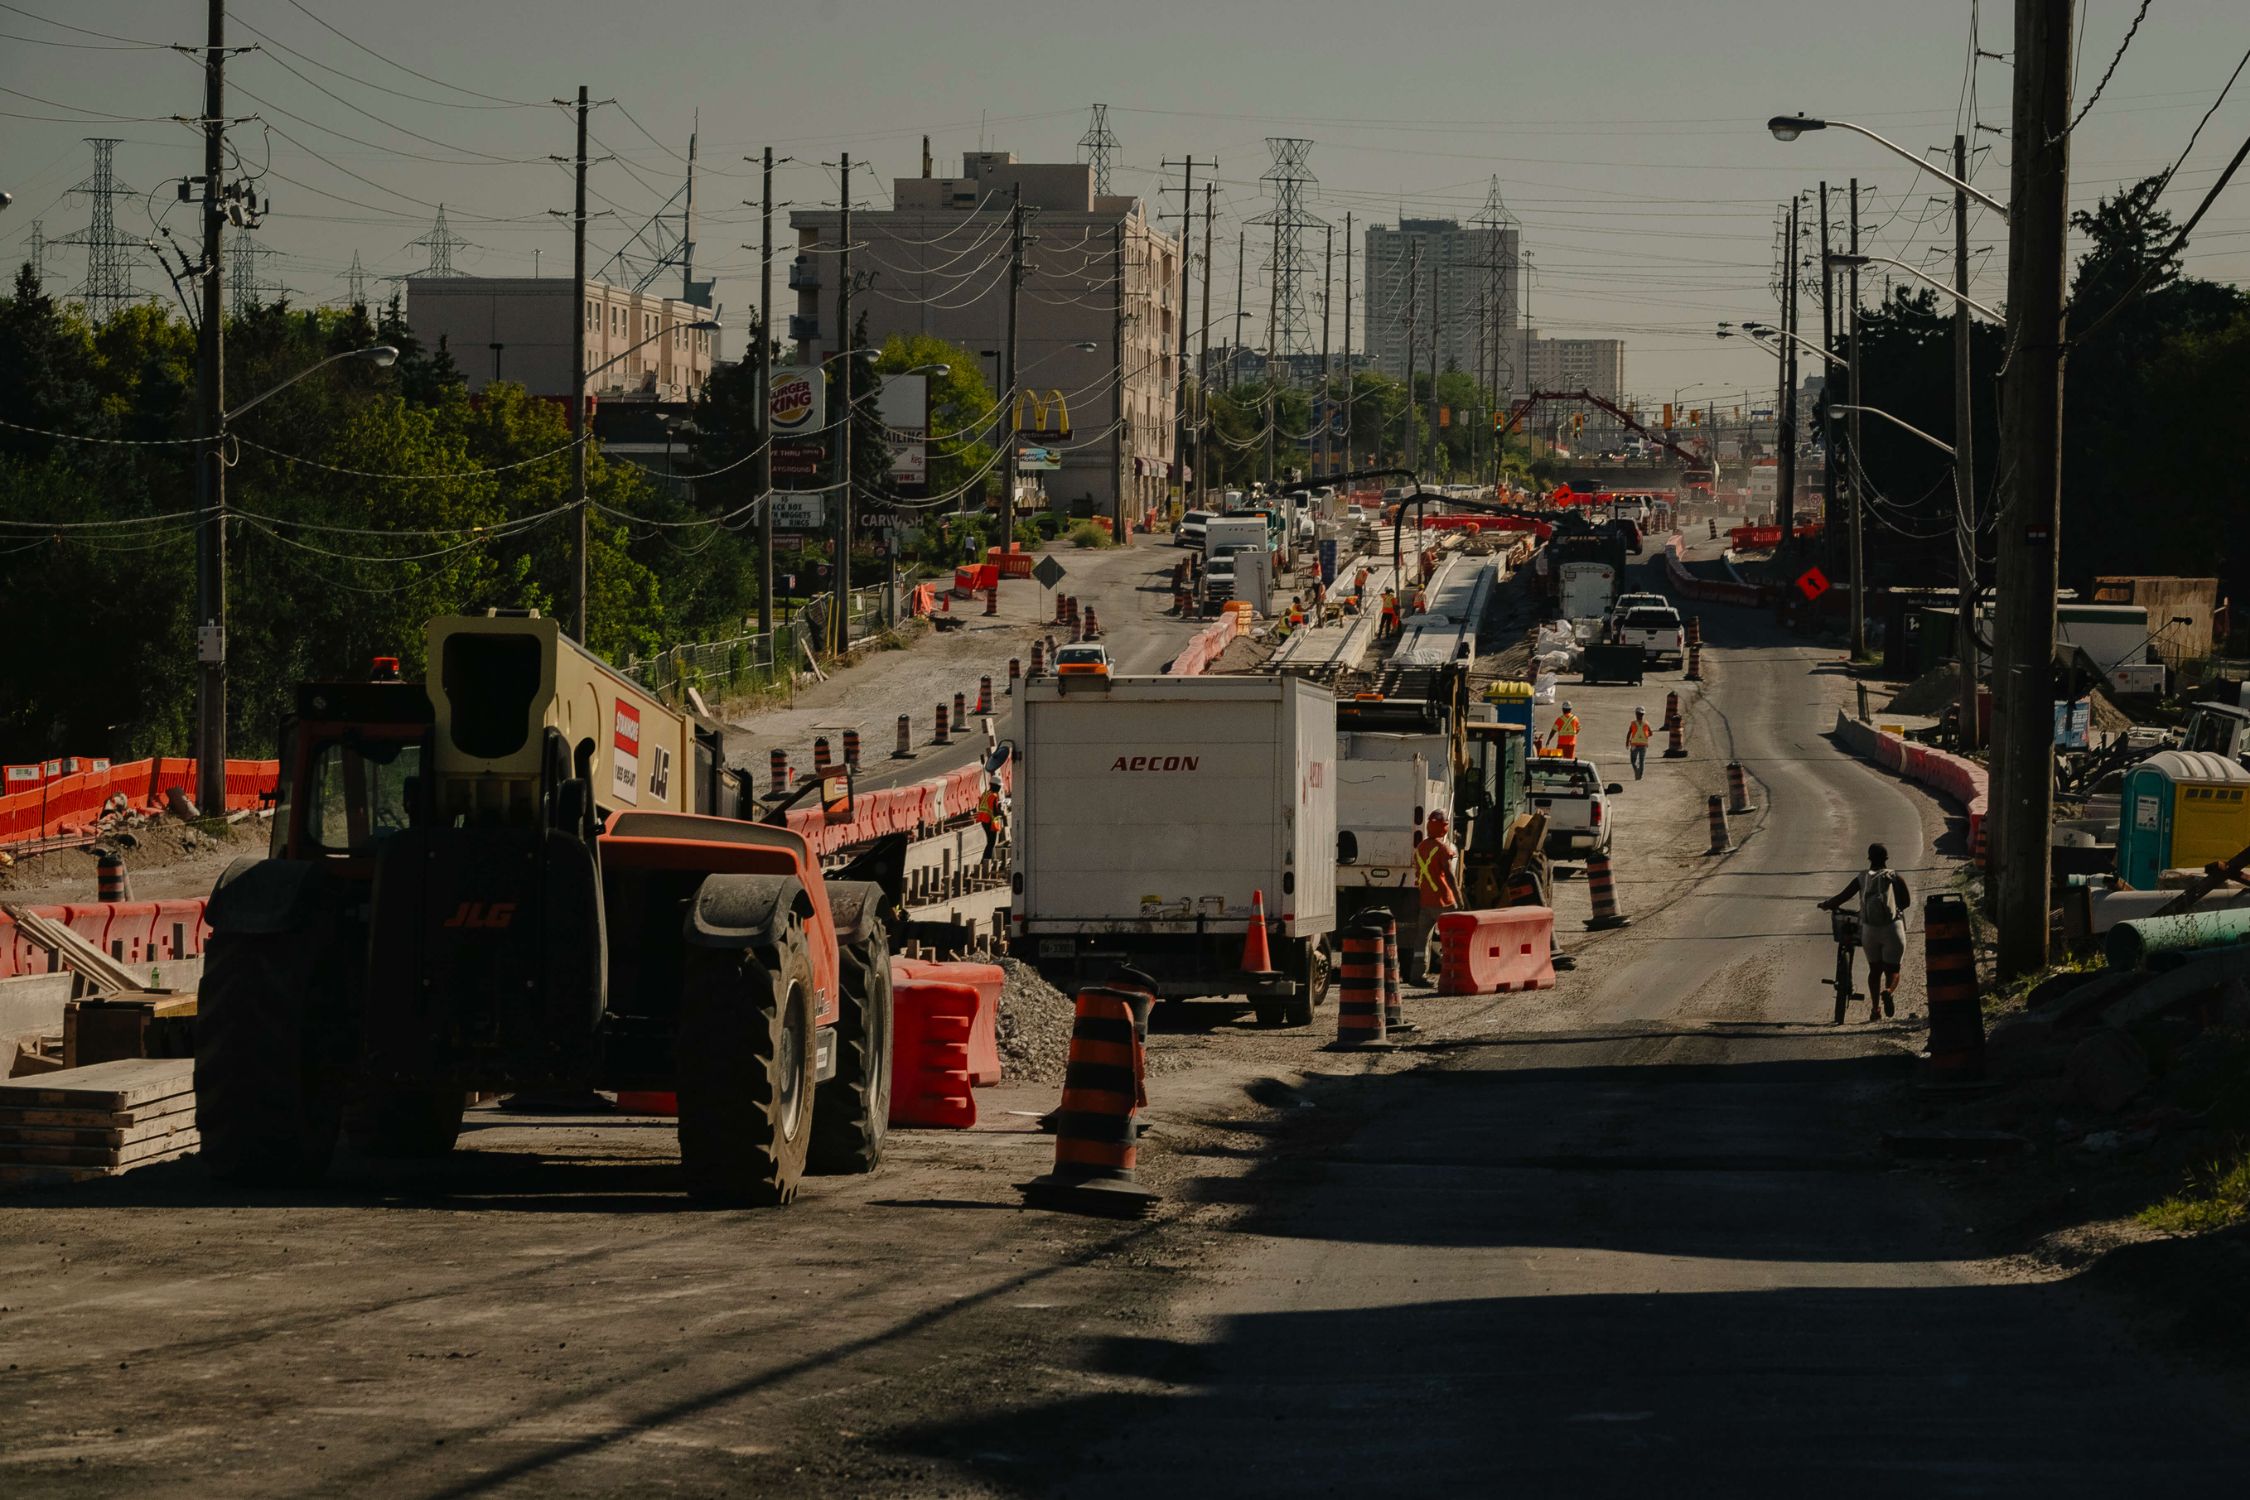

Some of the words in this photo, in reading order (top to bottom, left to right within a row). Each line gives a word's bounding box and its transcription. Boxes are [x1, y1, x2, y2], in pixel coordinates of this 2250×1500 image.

[771, 381, 809, 398] URGER
[884, 430, 923, 443] AILING
[772, 465, 811, 473] AYGROUND
[649, 745, 670, 801] JLG
[442, 901, 517, 928] JLG
